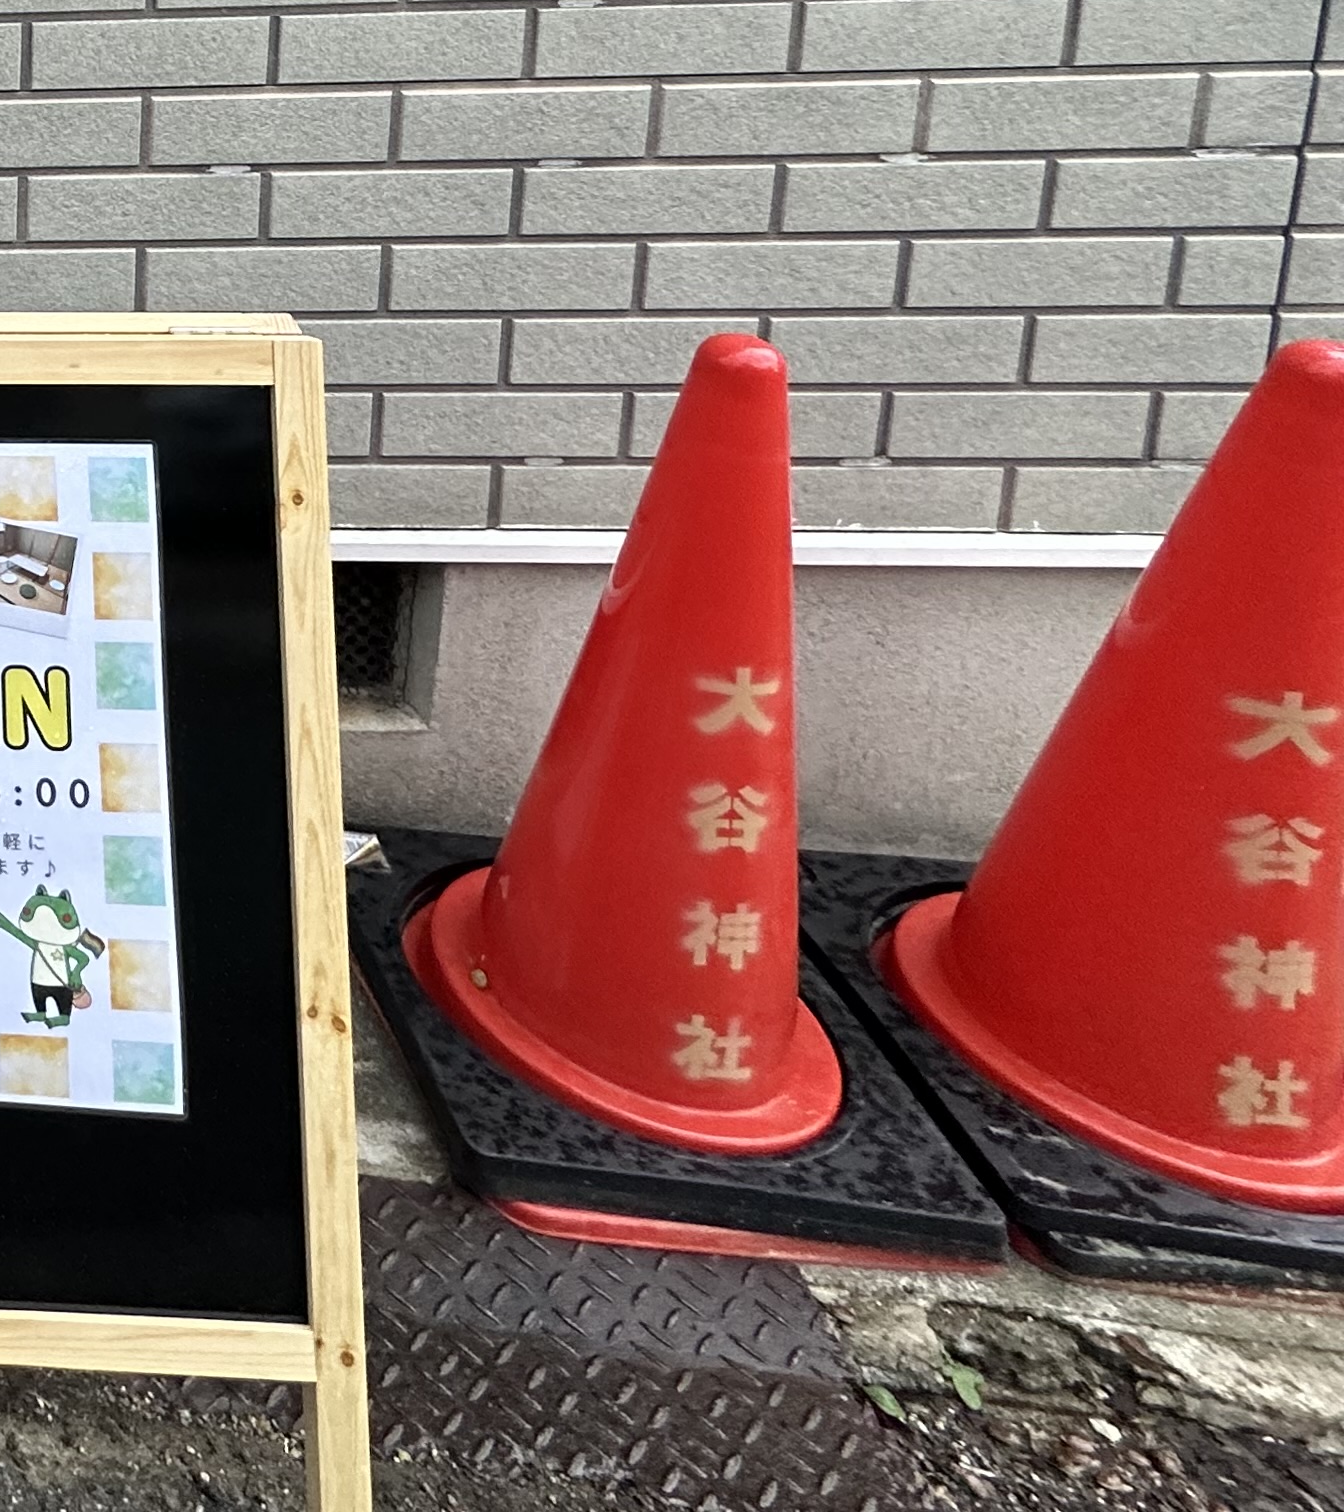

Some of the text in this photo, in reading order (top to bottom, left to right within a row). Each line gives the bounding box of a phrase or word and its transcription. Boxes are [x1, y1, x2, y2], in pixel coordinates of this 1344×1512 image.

[671, 667, 781, 1084] 大谷神社
[1216, 690, 1339, 1129] 大谷神社
